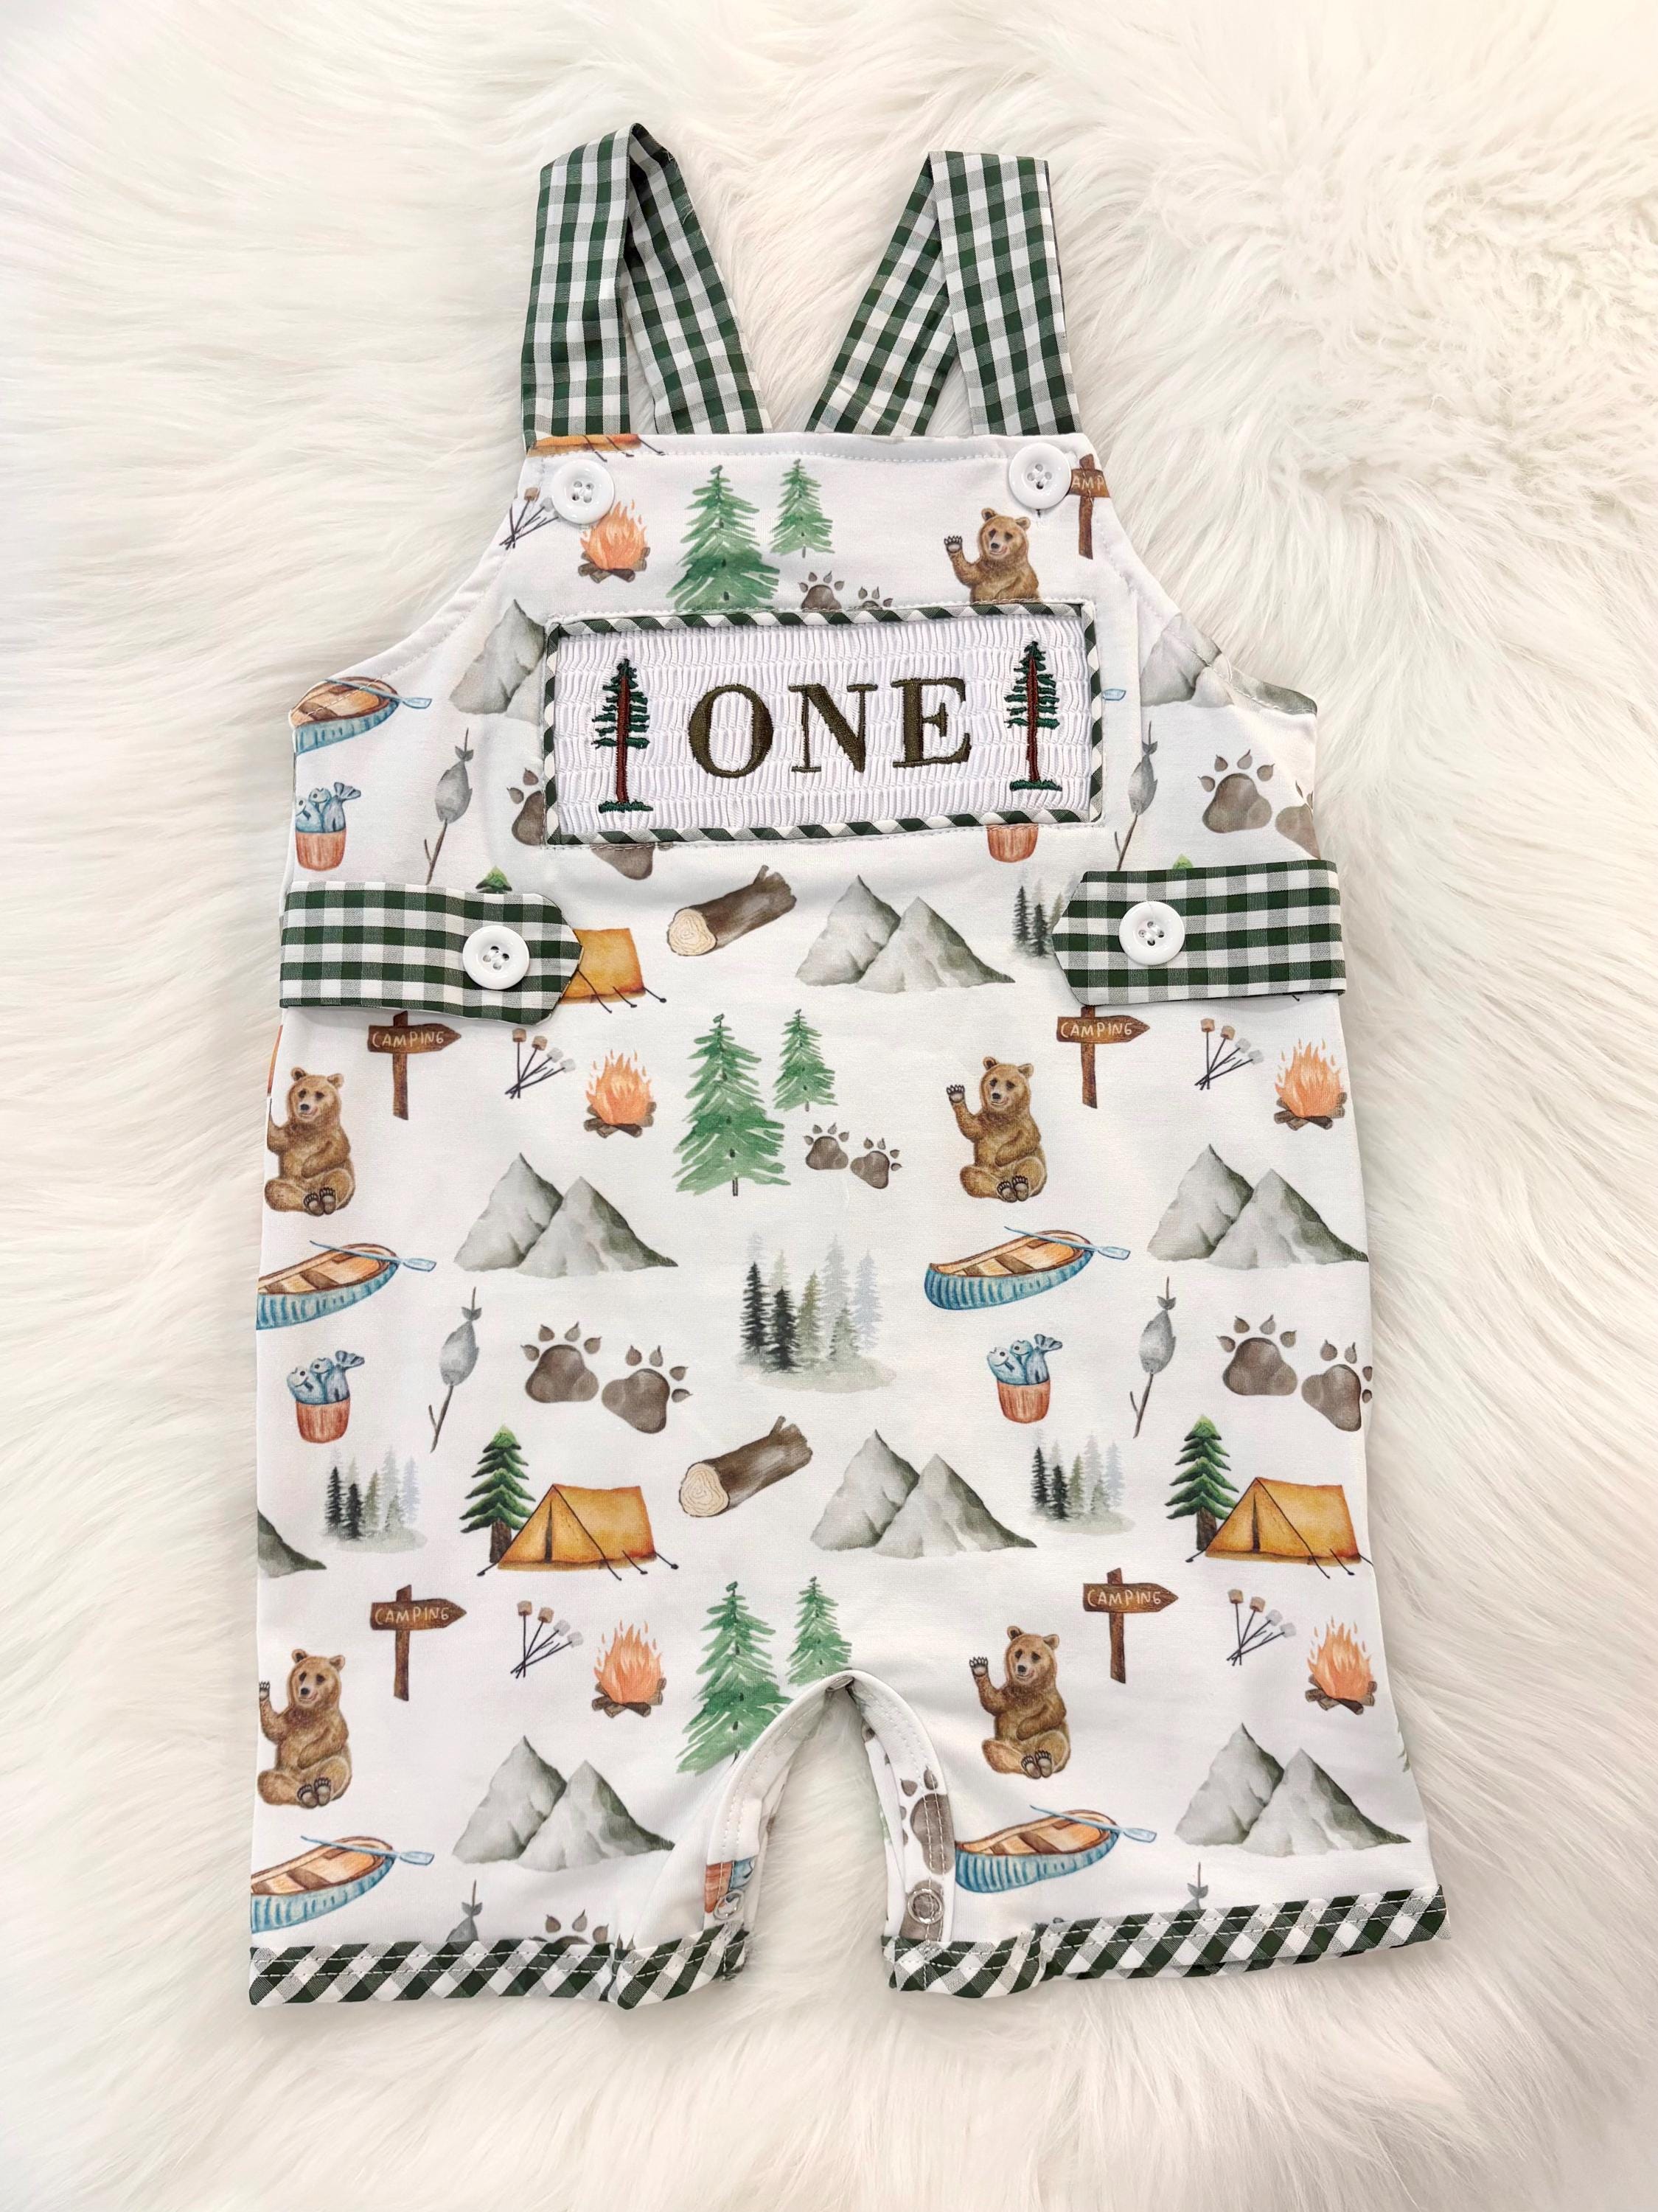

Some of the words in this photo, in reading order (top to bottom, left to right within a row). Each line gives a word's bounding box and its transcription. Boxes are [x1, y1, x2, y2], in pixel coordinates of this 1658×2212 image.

[688, 677, 972, 779] ONE
[1060, 1021, 1133, 1038] CAMPING
[372, 1031, 445, 1048] CAMPING
[1087, 1589, 1161, 1607] CAMPING
[375, 1606, 450, 1625] CAMPING
